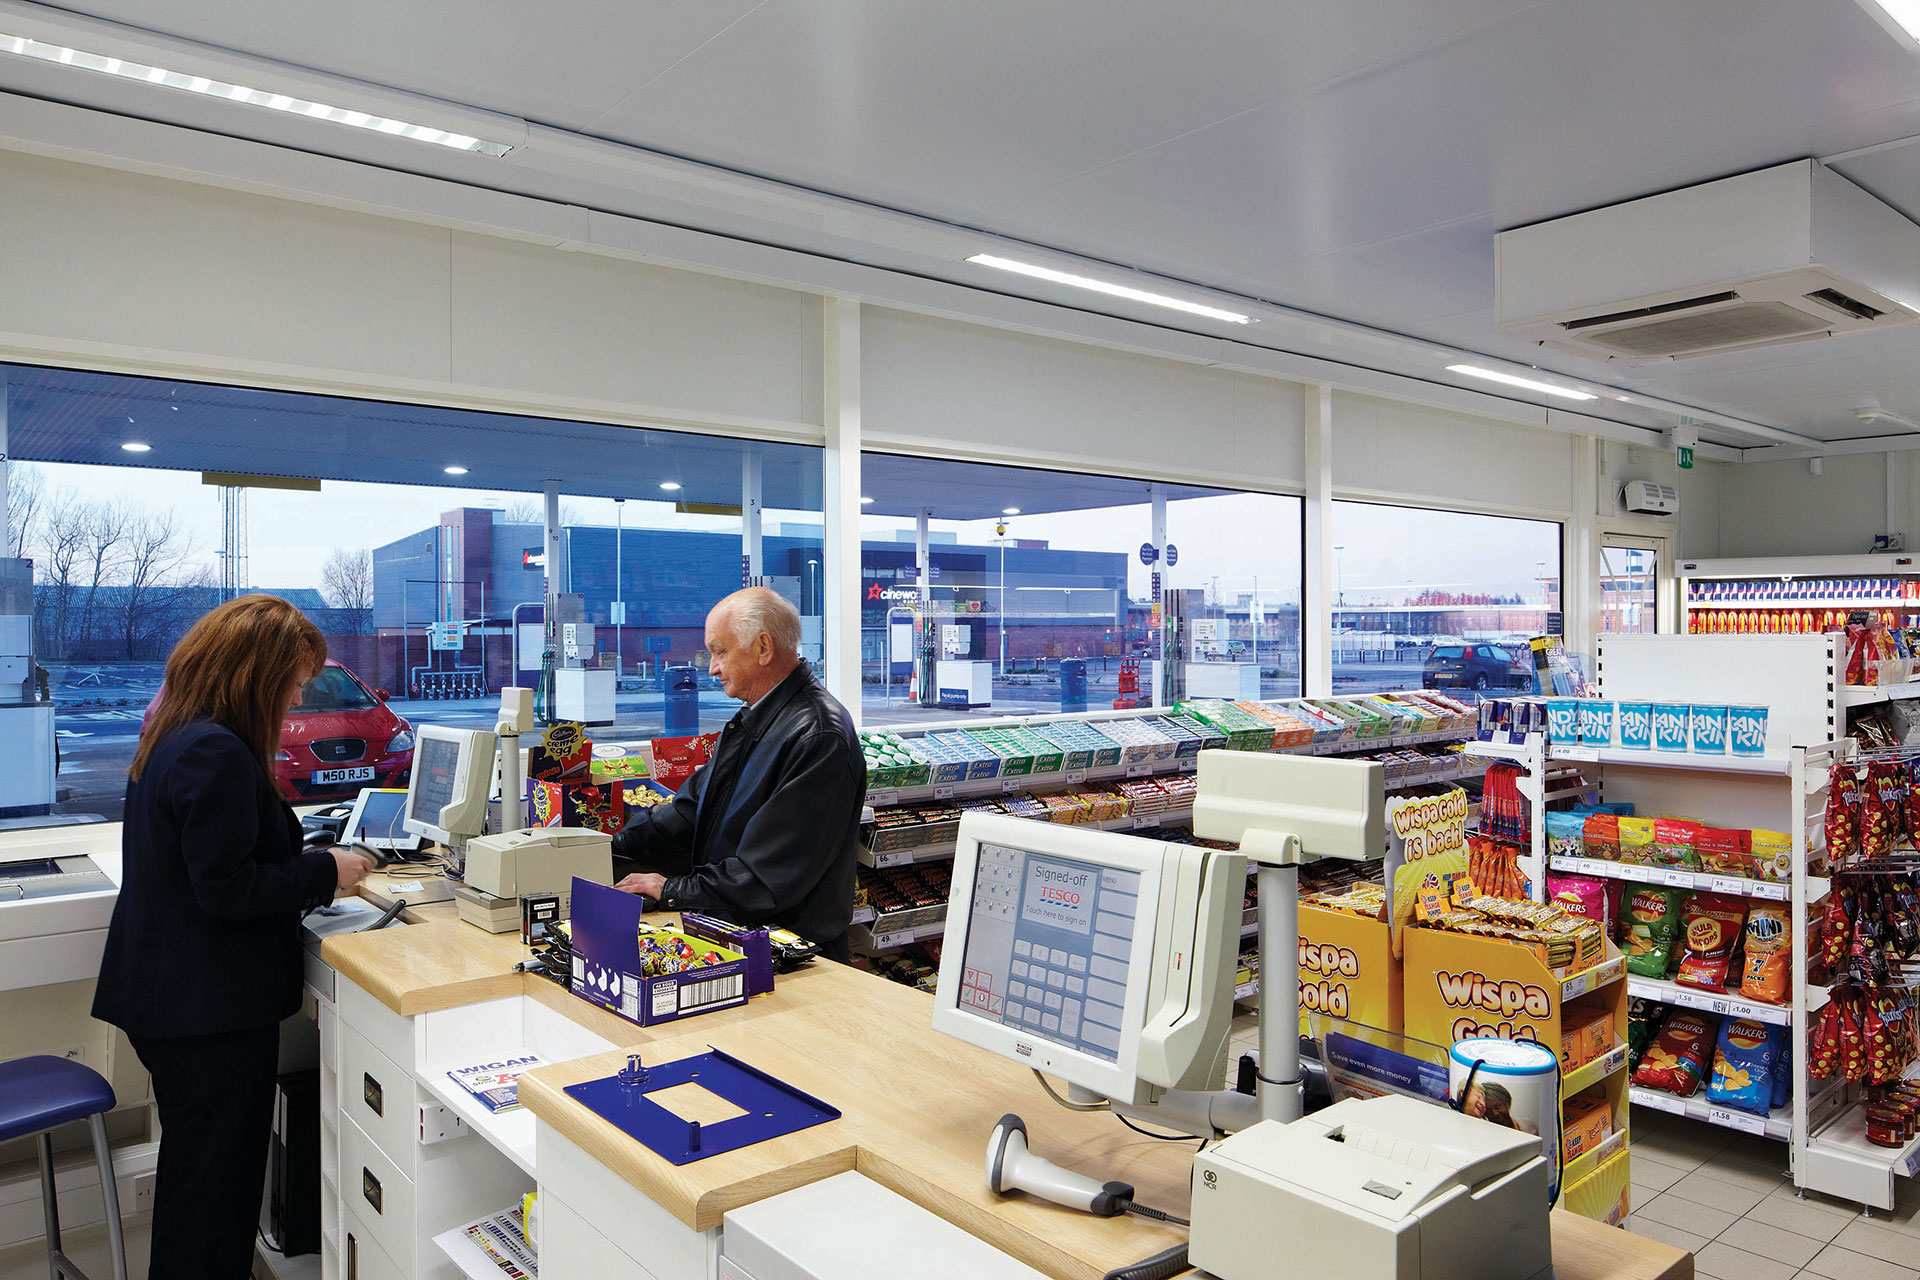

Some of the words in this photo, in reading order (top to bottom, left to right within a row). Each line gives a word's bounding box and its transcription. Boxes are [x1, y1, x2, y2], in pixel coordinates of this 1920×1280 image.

[26, 559, 33, 568] 2
[880, 588, 917, 600] cinewo
[1548, 709, 1579, 725] NDY
[1580, 710, 1613, 726] AND
[1620, 711, 1651, 727] CAN
[1730, 716, 1768, 733] CAN
[1582, 722, 1611, 740] KIN
[1624, 724, 1651, 741] KIN
[1659, 725, 1688, 744] KIN
[1696, 727, 1727, 745] KIN
[1736, 729, 1767, 747] KIN
[546, 734, 579, 747] creme
[550, 745, 573, 757] egg
[323, 770, 346, 782] M50
[348, 768, 370, 780] RJS
[1394, 804, 1439, 834] Wispa
[1438, 791, 1466, 822] Gold
[1406, 836, 1423, 862] is
[1426, 819, 1464, 856] back!
[1035, 866, 1089, 887] Signed-off
[1102, 876, 1117, 884] MENU
[1040, 885, 1080, 905] TESCO
[1631, 896, 1668, 913] WALKERS
[1026, 905, 1043, 915] Touch
[1043, 910, 1057, 919] here
[1065, 915, 1077, 925] sign
[1662, 924, 1670, 932] 6
[1691, 922, 1713, 936] HULA
[1747, 918, 1783, 937] MINI
[1691, 930, 1719, 947] HOOPS
[1298, 936, 1359, 977] ispa
[1681, 949, 1693, 966] 7
[1751, 959, 1767, 973] 7
[1437, 970, 1551, 1018] Wispa
[1712, 1001, 1728, 1013] NEW
[1732, 1006, 1751, 1014] £1.00
[1669, 1020, 1705, 1035] WALKERS
[1728, 1024, 1768, 1040] WALKERS
[1691, 1042, 1700, 1051] 6
[1762, 1051, 1770, 1061] 6
[456, 1055, 538, 1074] WIGAN
[1331, 1051, 1350, 1063] Save
[1349, 1058, 1366, 1068] even
[1366, 1063, 1386, 1075] more
[1386, 1070, 1412, 1084] money
[1712, 1111, 1731, 1120] £1.58
[1203, 1181, 1217, 1190] NCR
